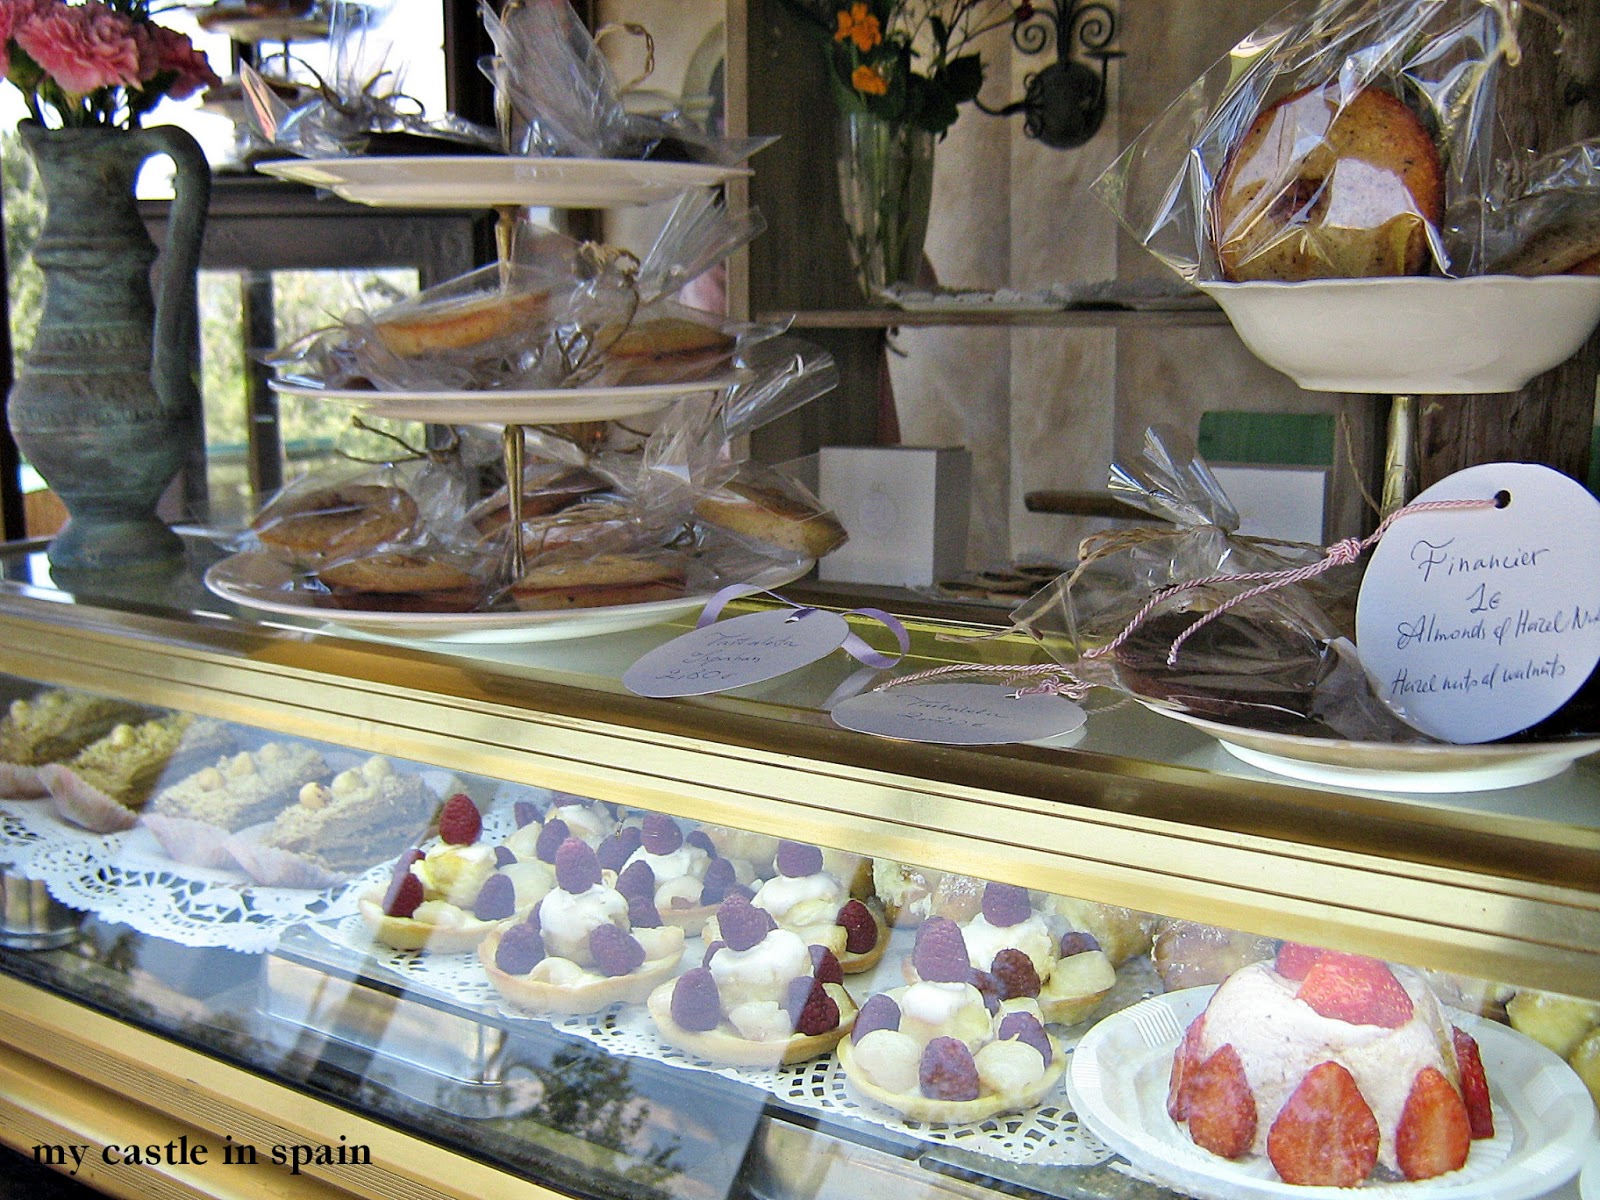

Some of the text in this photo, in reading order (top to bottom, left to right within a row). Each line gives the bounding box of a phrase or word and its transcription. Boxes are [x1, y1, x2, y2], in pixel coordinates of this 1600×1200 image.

[1410, 537, 1550, 582] Financier
[1466, 582, 1502, 613] 1€
[1397, 613, 1486, 649] Almonds
[1514, 609, 1567, 638] Hazel
[1392, 668, 1438, 695] Hazel
[1503, 653, 1566, 682] walnuts
